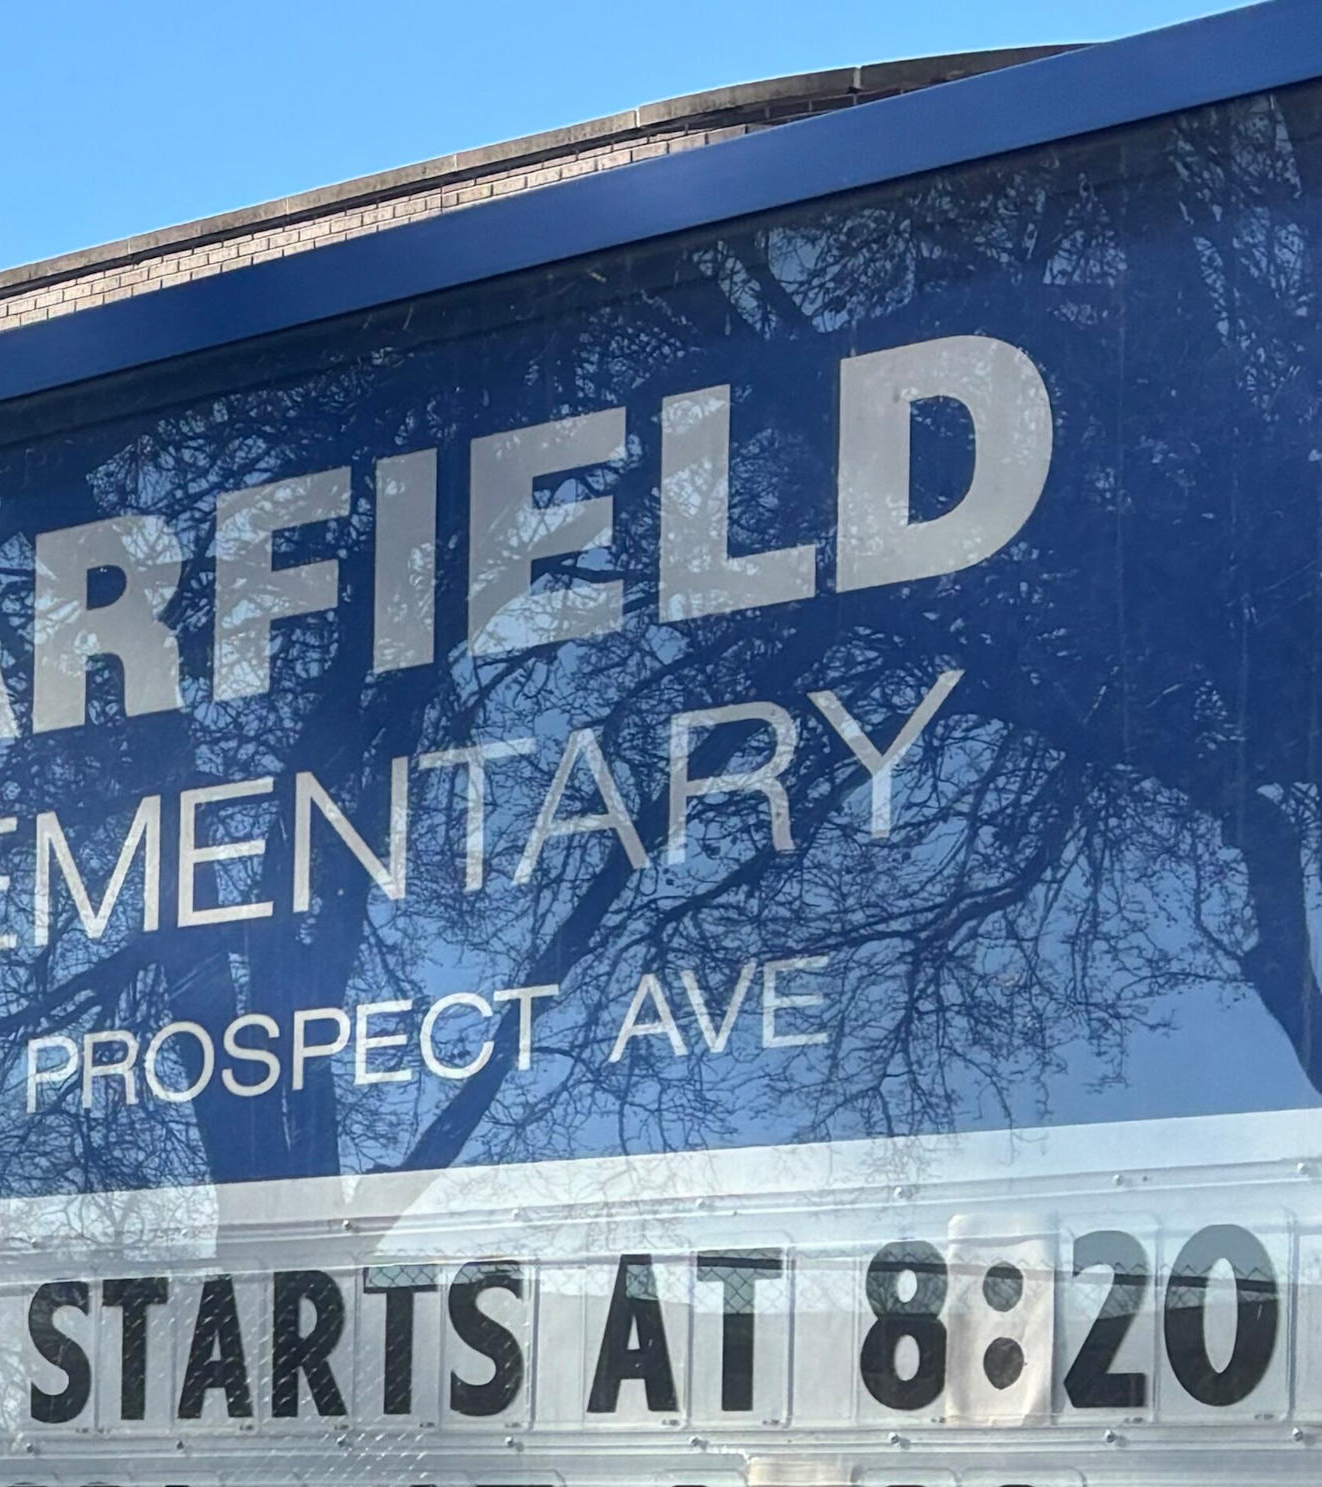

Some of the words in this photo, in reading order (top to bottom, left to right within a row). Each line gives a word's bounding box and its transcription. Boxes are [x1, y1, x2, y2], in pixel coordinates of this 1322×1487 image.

[26, 985, 561, 1113] PROSPECT
[609, 954, 830, 1063] AVE
[28, 1260, 525, 1424] STARTS
[587, 1247, 783, 1413] AT
[860, 1223, 1279, 1412] 8:20
